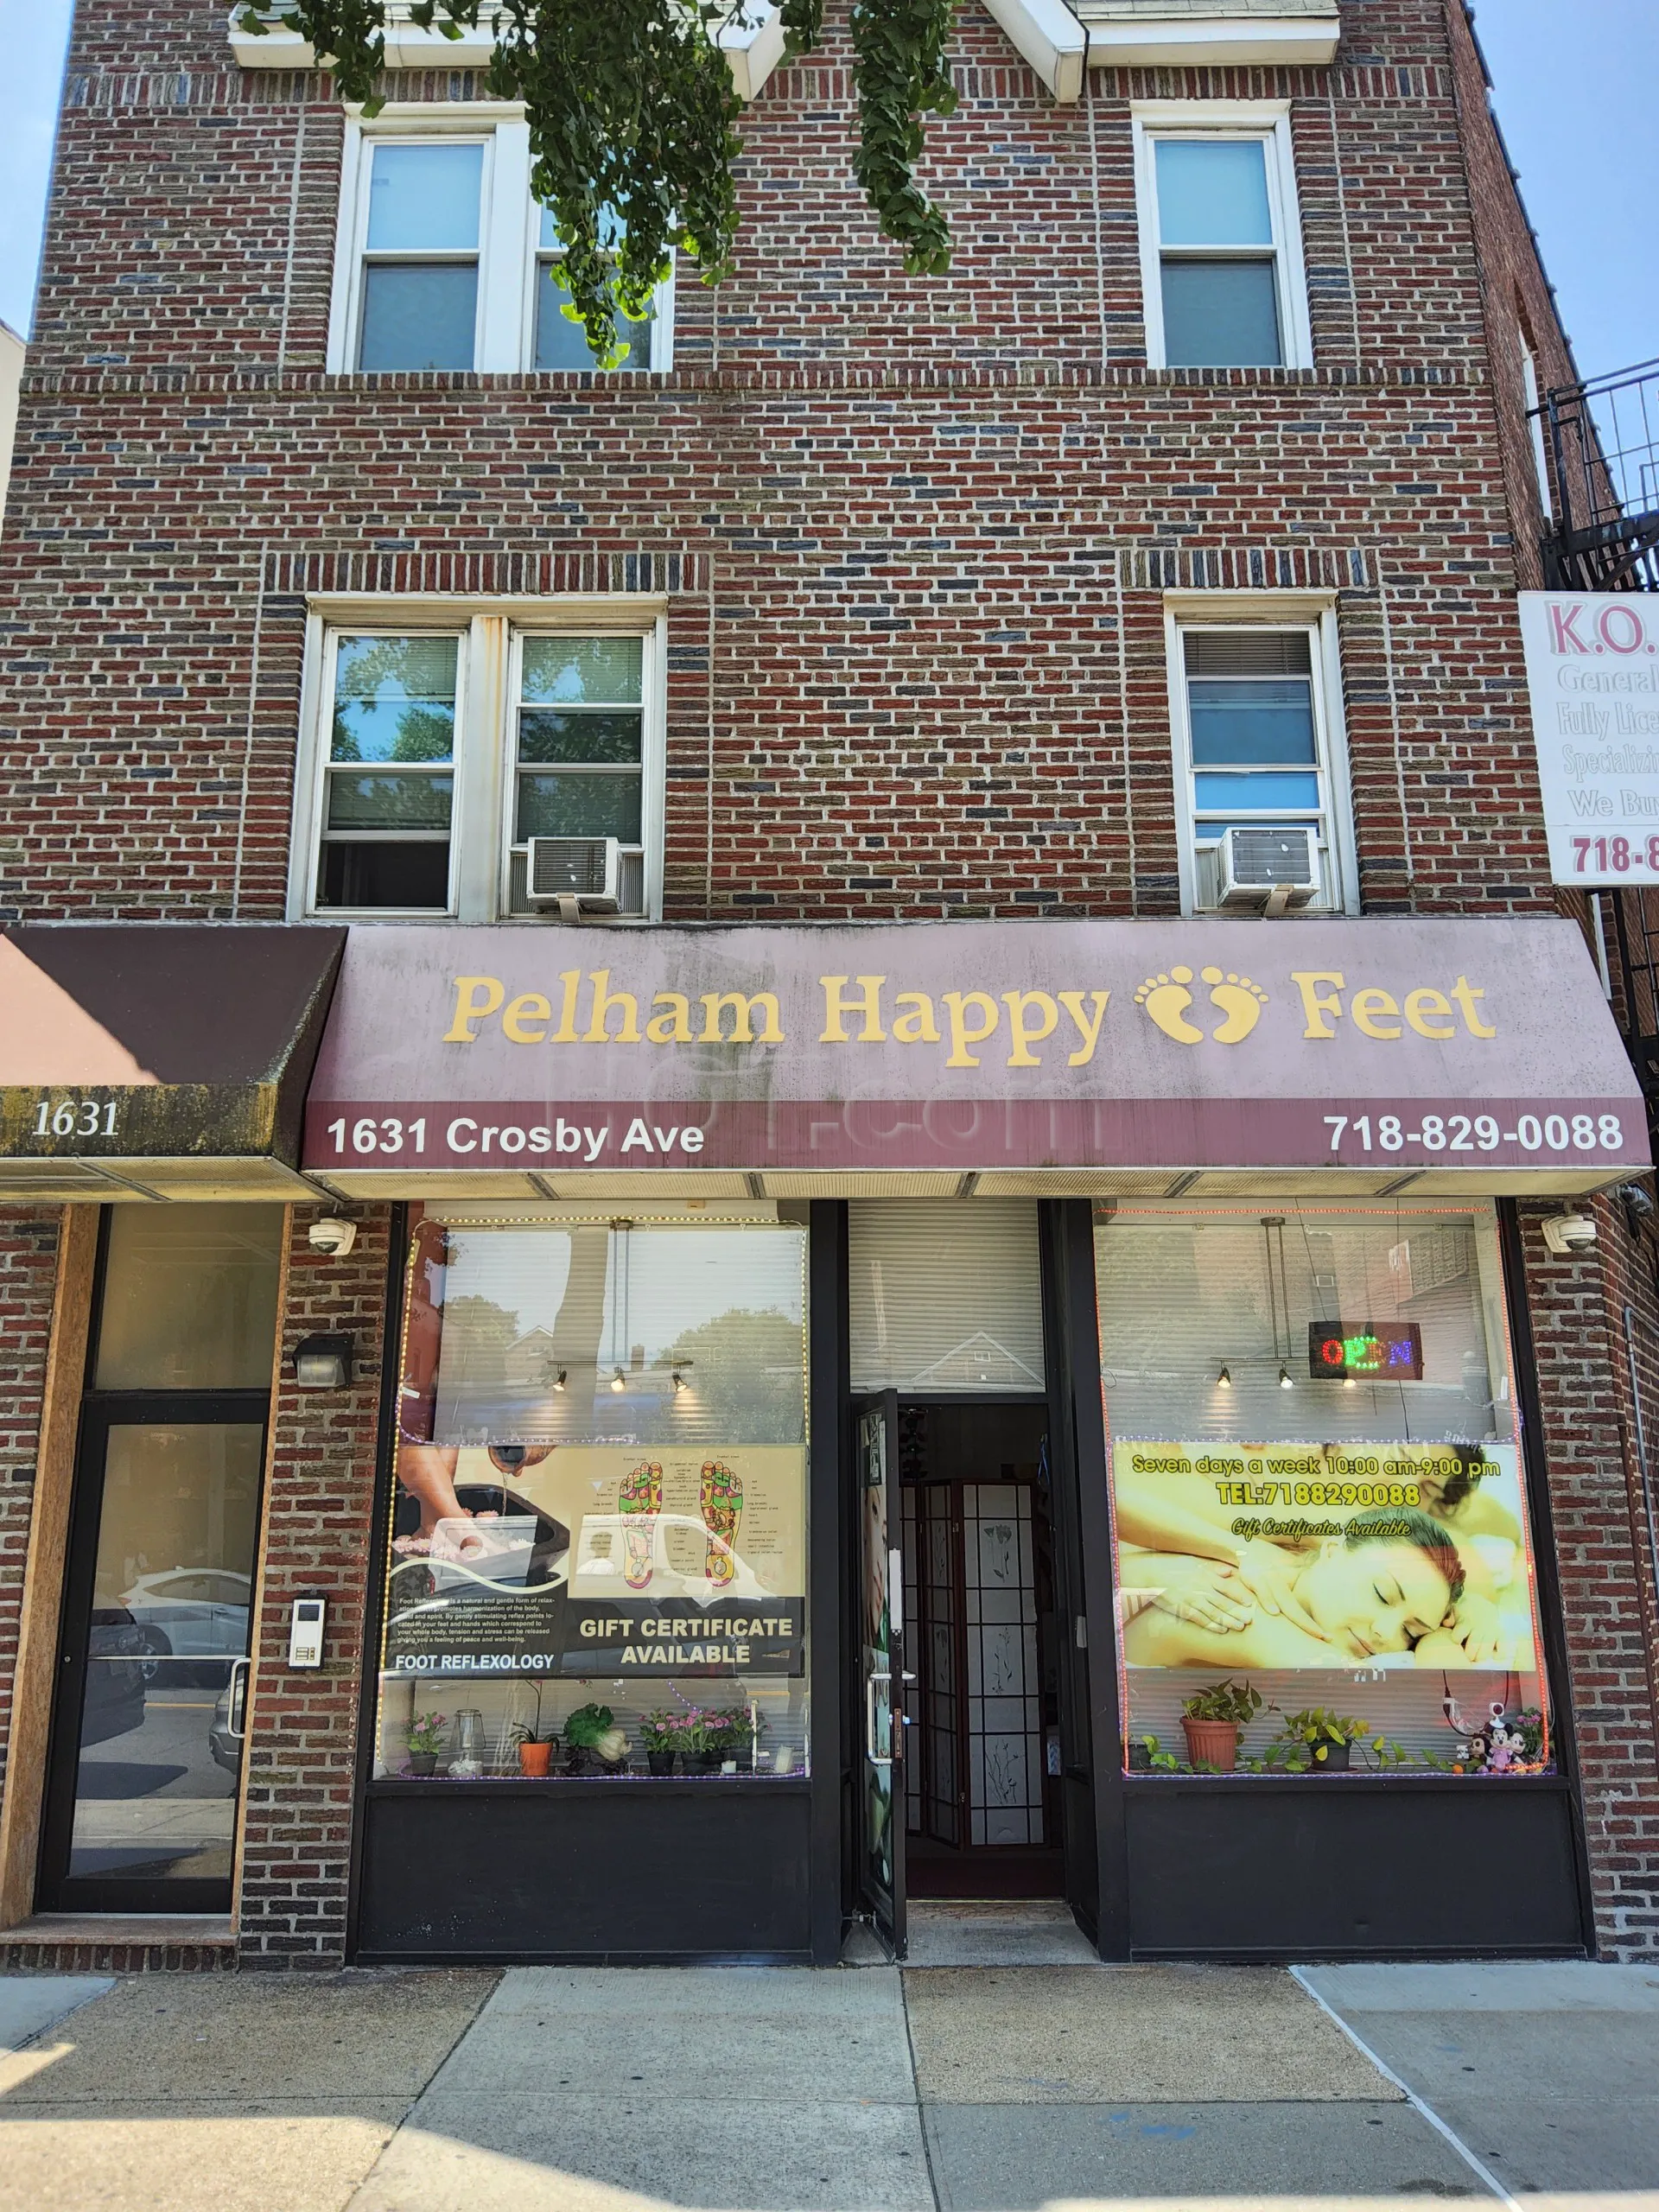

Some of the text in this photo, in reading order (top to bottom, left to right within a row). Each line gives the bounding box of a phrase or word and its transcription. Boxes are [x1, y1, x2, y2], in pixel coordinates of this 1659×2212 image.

[1548, 602, 1656, 655] K.O.
[1558, 664, 1659, 693] General
[1556, 702, 1659, 741] Fully Lice
[1567, 790, 1613, 817] We
[442, 969, 1496, 1066] Pelham Happy Feet
[32, 1101, 119, 1136] 1631
[327, 1117, 705, 1162] 1631 Crosby Ave
[1323, 1114, 1624, 1152] 718-829-0088
[1322, 1338, 1412, 1366] OPEN
[1133, 1454, 1501, 1479] Seven days a week 10:00 am-9:00 pm
[1216, 1482, 1421, 1506] TEL:7188290088
[1231, 1517, 1412, 1542] Gift Certificates Available
[579, 1618, 792, 1637] GIFT CERTIFICATE
[395, 1654, 554, 1669] FOOT REFLEXOLOGY
[620, 1645, 750, 1663] AVAILABLE
